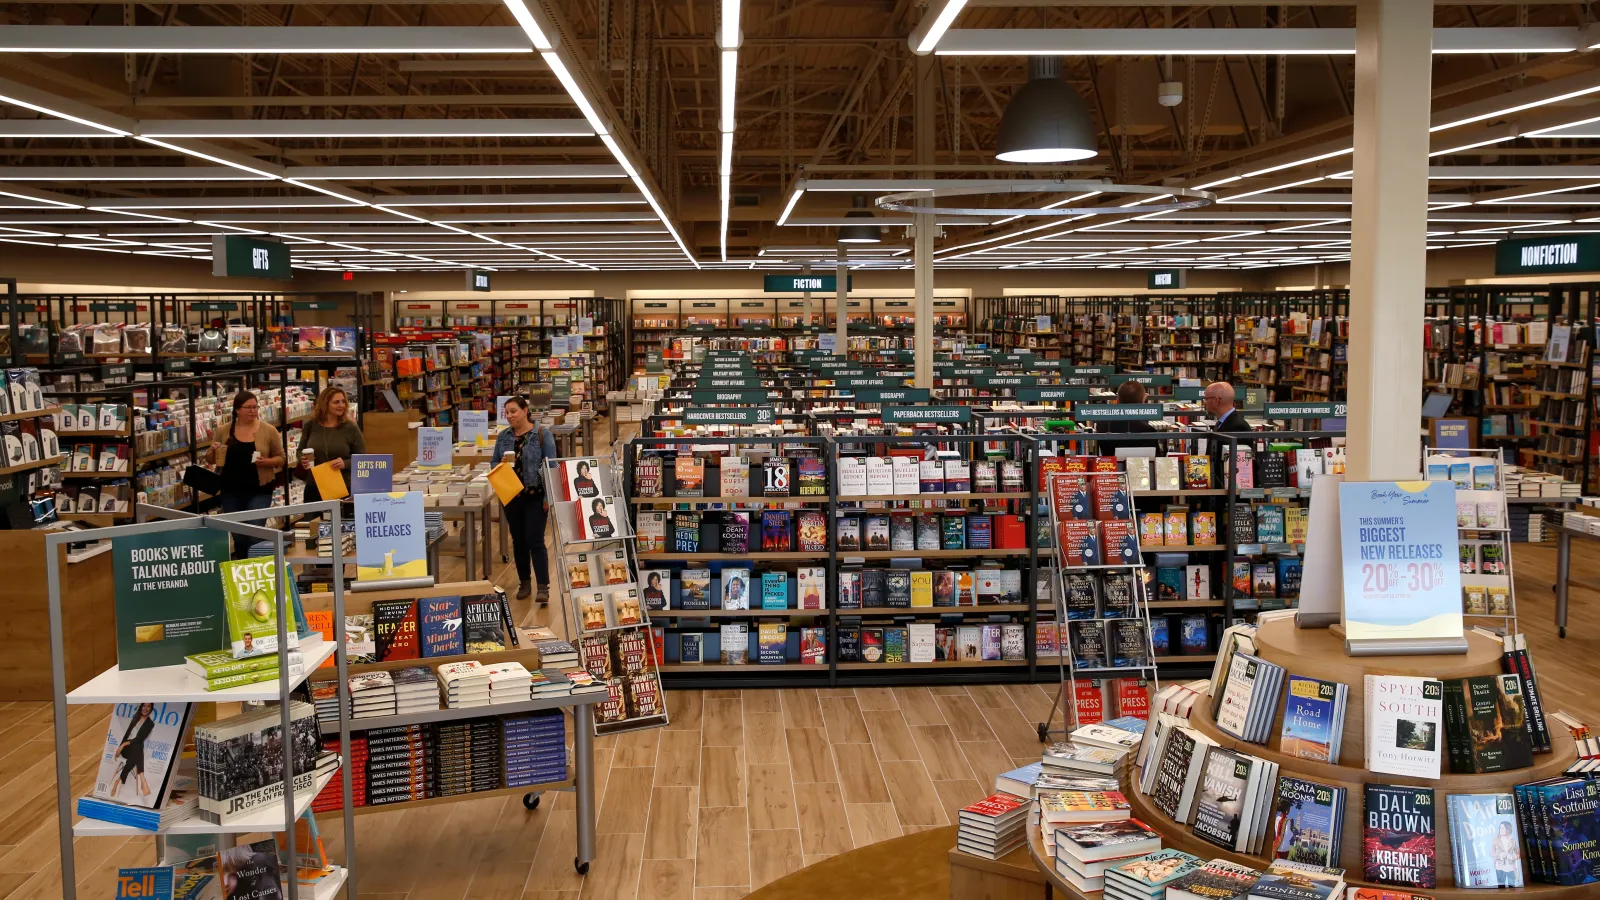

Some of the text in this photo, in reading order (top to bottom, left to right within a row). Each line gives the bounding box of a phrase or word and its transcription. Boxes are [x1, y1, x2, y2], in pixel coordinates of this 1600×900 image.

[252, 247, 269, 270] GIFTS
[1520, 243, 1578, 267] NONFICTION
[793, 279, 822, 289] FICTION
[686, 412, 714, 420] HARDCOVER
[715, 412, 747, 420] BESTSELLERS
[893, 410, 959, 418] PAPERBACK BESTSELLERS
[357, 460, 387, 470] GIFTS FOR
[636, 466, 660, 476] HARRIS
[357, 470, 369, 478] DAD
[765, 467, 788, 490] 18
[1403, 496, 1429, 505] Summer
[366, 512, 386, 524] NEW
[764, 512, 789, 521] DANIELLE
[1360, 517, 1404, 526] THIS SUMMER'S
[367, 524, 412, 538] RELEASES
[676, 531, 693, 541] NEON
[1360, 527, 1406, 542] BIGGEST
[131, 544, 204, 562] BOOKS WE'RE
[676, 540, 699, 552] PREY
[1360, 544, 1443, 560] NEW RELEASES
[131, 560, 216, 579] TALKING ABOUT
[133, 579, 188, 591] AT THE VERANDA
[238, 578, 276, 595] DIET
[429, 600, 454, 613] Star-
[466, 602, 499, 614] AFRICAN
[424, 608, 458, 624] Crossed
[466, 611, 500, 623] SAMURAI
[426, 631, 456, 645] Minnie
[432, 640, 460, 654] Darke
[631, 682, 656, 694] HARRIS
[1380, 682, 1424, 698] SPYIN
[1076, 698, 1100, 708] PRESS
[1121, 697, 1146, 707] PRESS
[1378, 701, 1437, 717] SOUTH
[1525, 680, 1545, 732] ULTIMATE GRILLING
[1296, 704, 1321, 718] Road
[1293, 715, 1321, 729] Home
[384, 735, 409, 743] PATTERSON
[1377, 750, 1435, 764] Tony Horwitz
[245, 773, 312, 801] THE CHROCLES
[1204, 774, 1243, 798] VANISH
[1294, 782, 1316, 794] SATA
[1565, 787, 1585, 800] Lisa
[226, 796, 245, 815] JR
[245, 800, 257, 808] OF
[257, 795, 268, 805] SAN
[1553, 798, 1599, 817] Scottoline
[1196, 812, 1219, 826] ANNIE
[1369, 811, 1430, 834] BROWN
[1194, 820, 1233, 842] JACOBSEN
[1562, 839, 1597, 852] Someone
[1145, 852, 1170, 862] NEXT
[1376, 848, 1427, 868] KREMLIN
[236, 866, 267, 879] Wonder
[1379, 865, 1419, 883] STRIKE
[117, 874, 154, 898] Tell
[250, 886, 277, 899] Causes
[1256, 884, 1322, 900] PIONEERS
